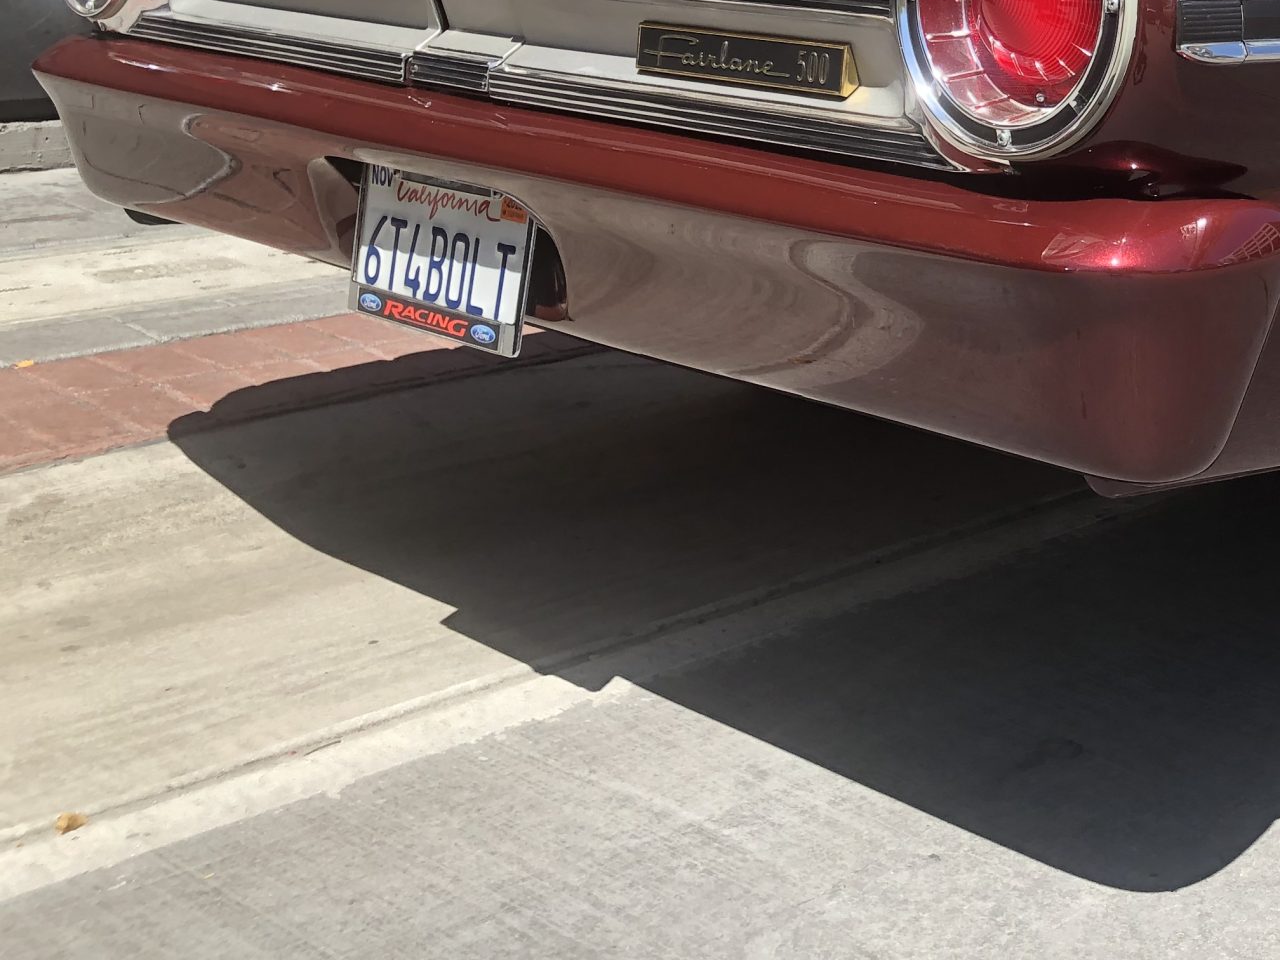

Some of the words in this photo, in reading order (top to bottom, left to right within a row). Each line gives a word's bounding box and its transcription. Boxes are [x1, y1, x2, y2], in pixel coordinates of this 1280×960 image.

[643, 35, 791, 78] Fairlane
[796, 49, 831, 85] 500
[371, 165, 394, 187] NOV
[397, 181, 500, 222] California
[364, 216, 517, 321] 6T4BOLT
[384, 299, 469, 337] RACING
